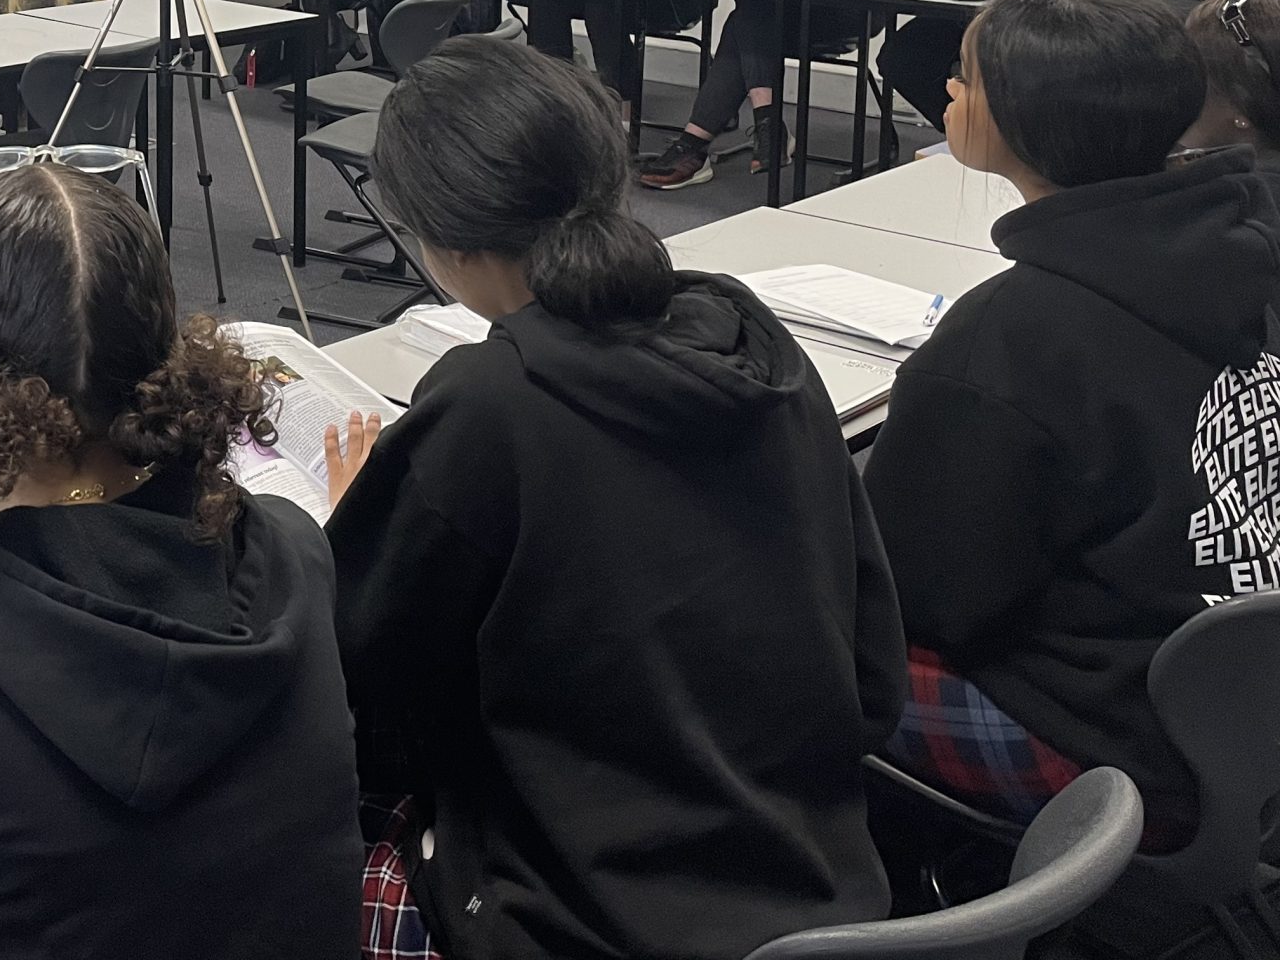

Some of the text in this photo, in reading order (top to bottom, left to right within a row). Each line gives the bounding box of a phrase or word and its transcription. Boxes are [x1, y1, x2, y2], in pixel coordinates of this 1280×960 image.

[1195, 364, 1241, 433] ELITE
[1191, 401, 1239, 474] ELITE
[1204, 428, 1259, 495] ELITE
[1187, 477, 1246, 541] ELITE
[1195, 514, 1271, 567] ELITE
[1229, 543, 1280, 594] ELIT
